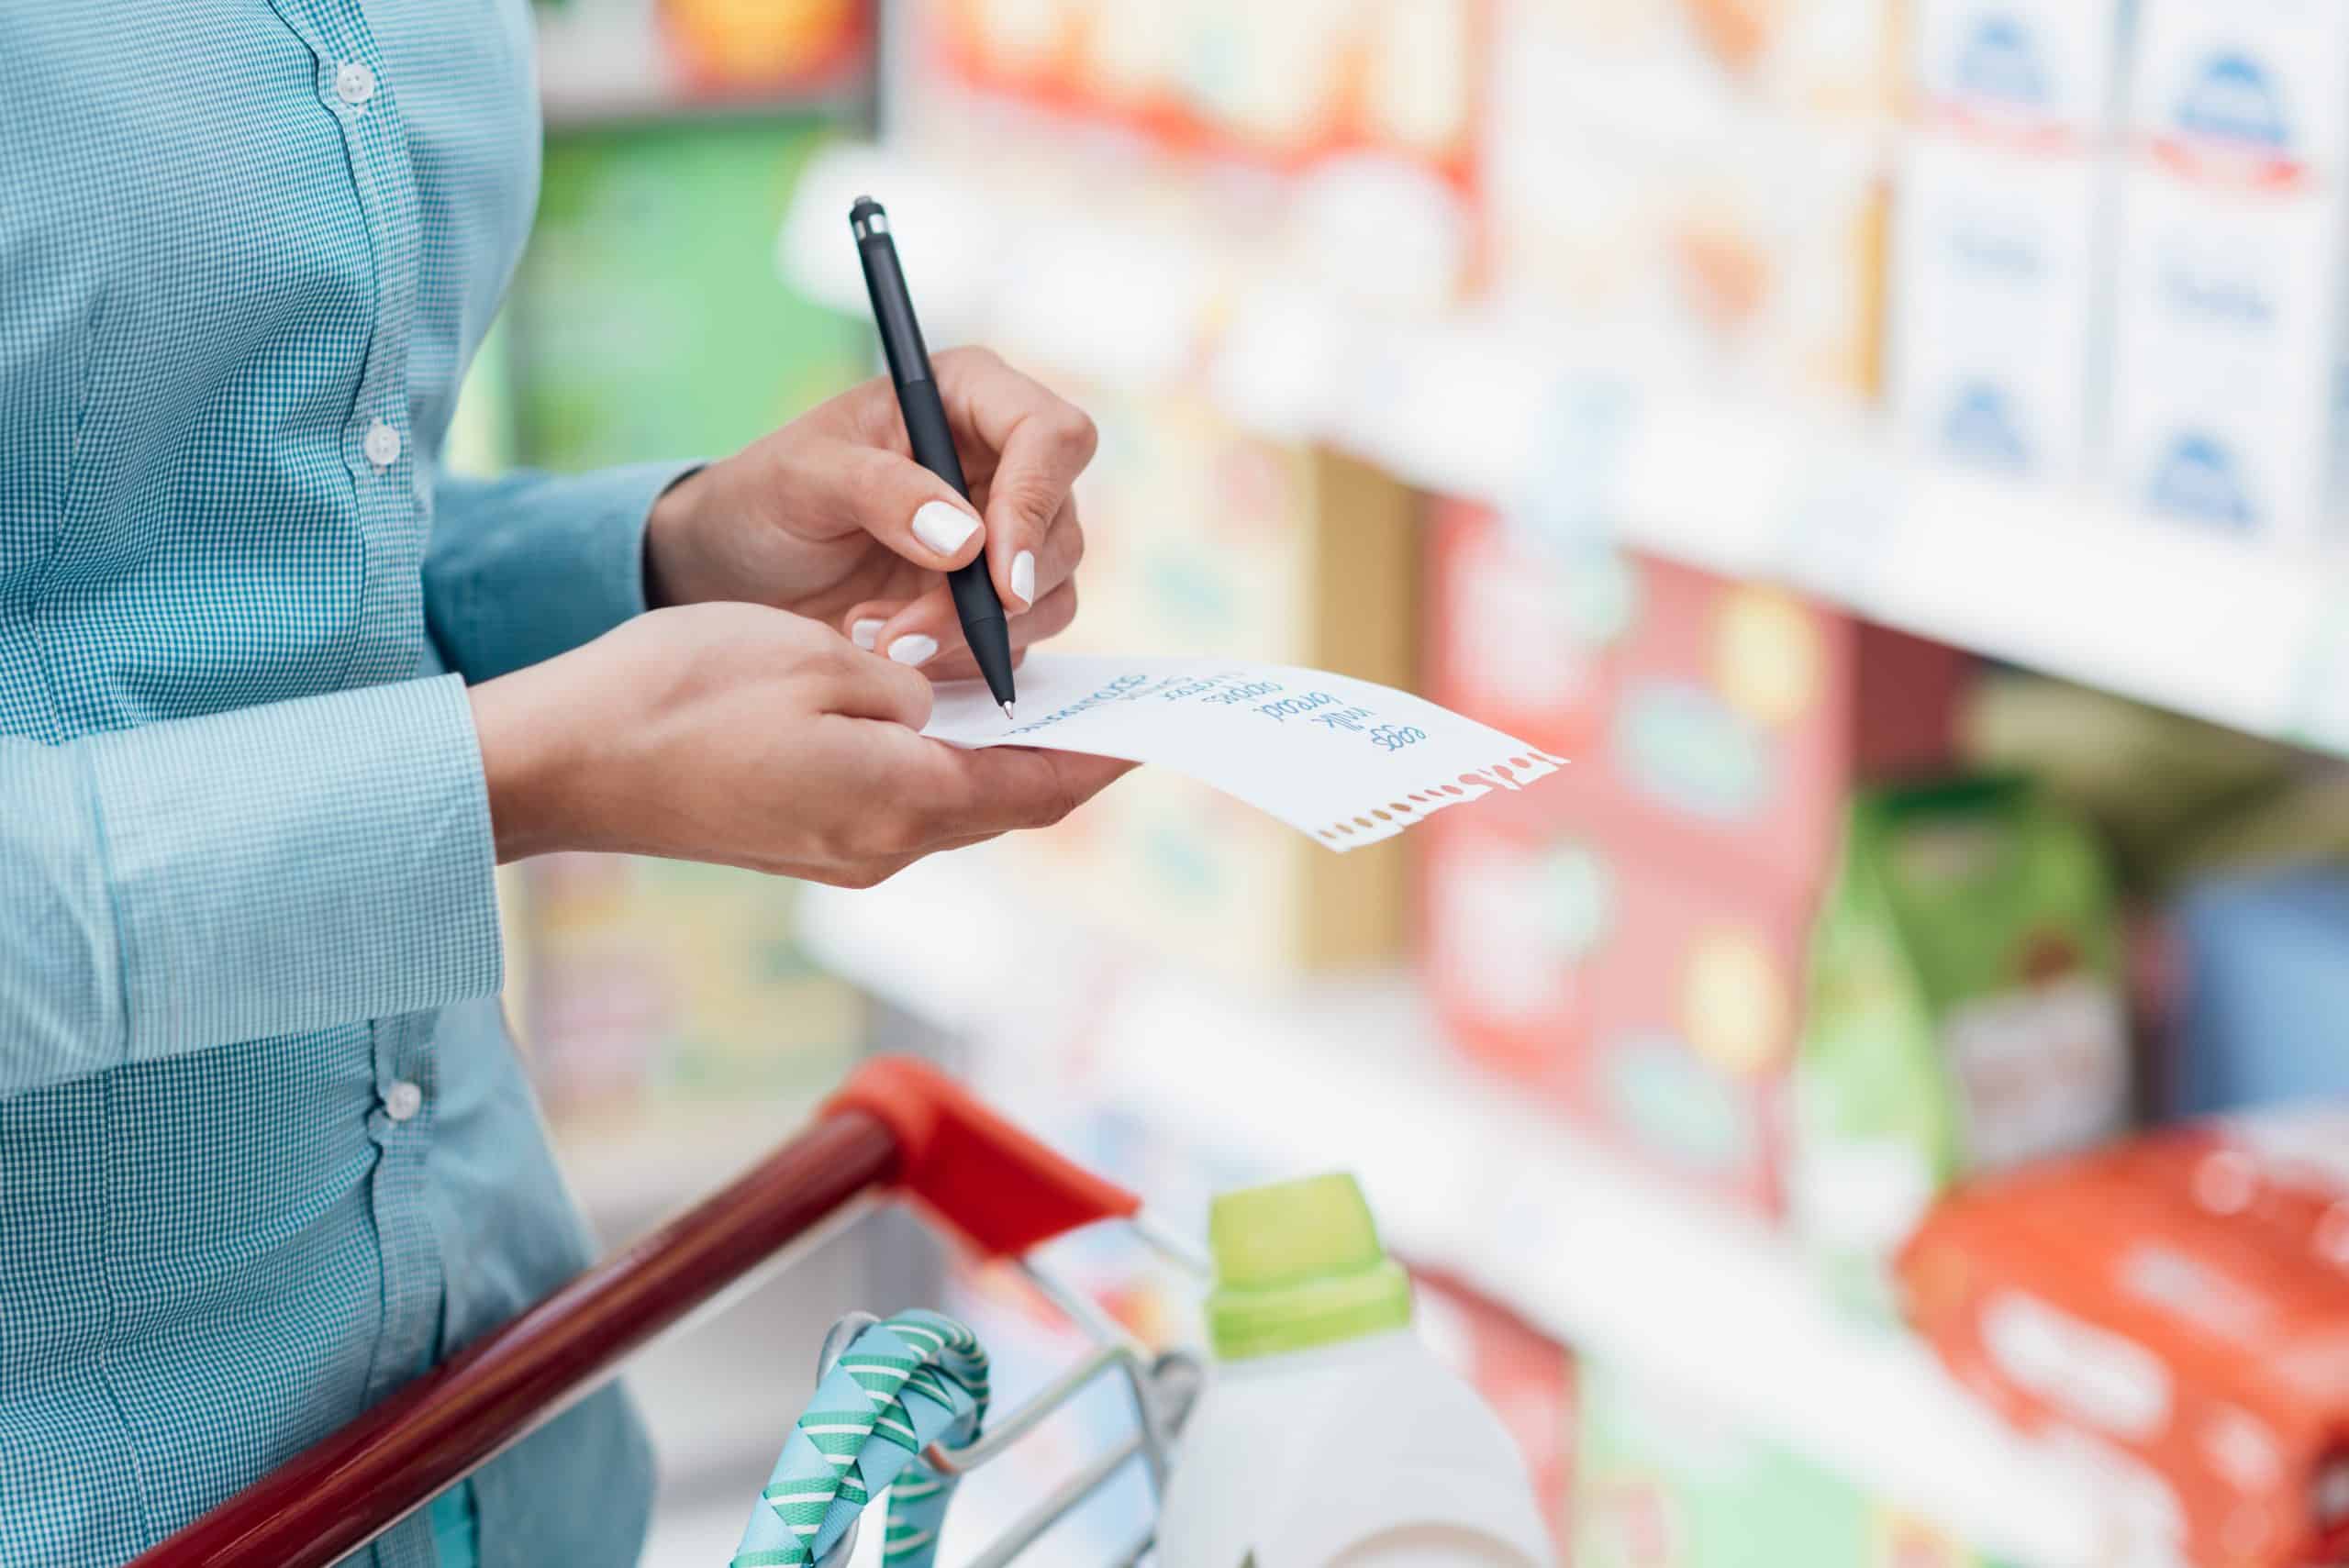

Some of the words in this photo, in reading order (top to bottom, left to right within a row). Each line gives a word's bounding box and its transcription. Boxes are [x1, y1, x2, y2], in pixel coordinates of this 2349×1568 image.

[1252, 691, 1343, 722] bread
[1309, 706, 1376, 731] milk
[1370, 724, 1427, 751] eggs
